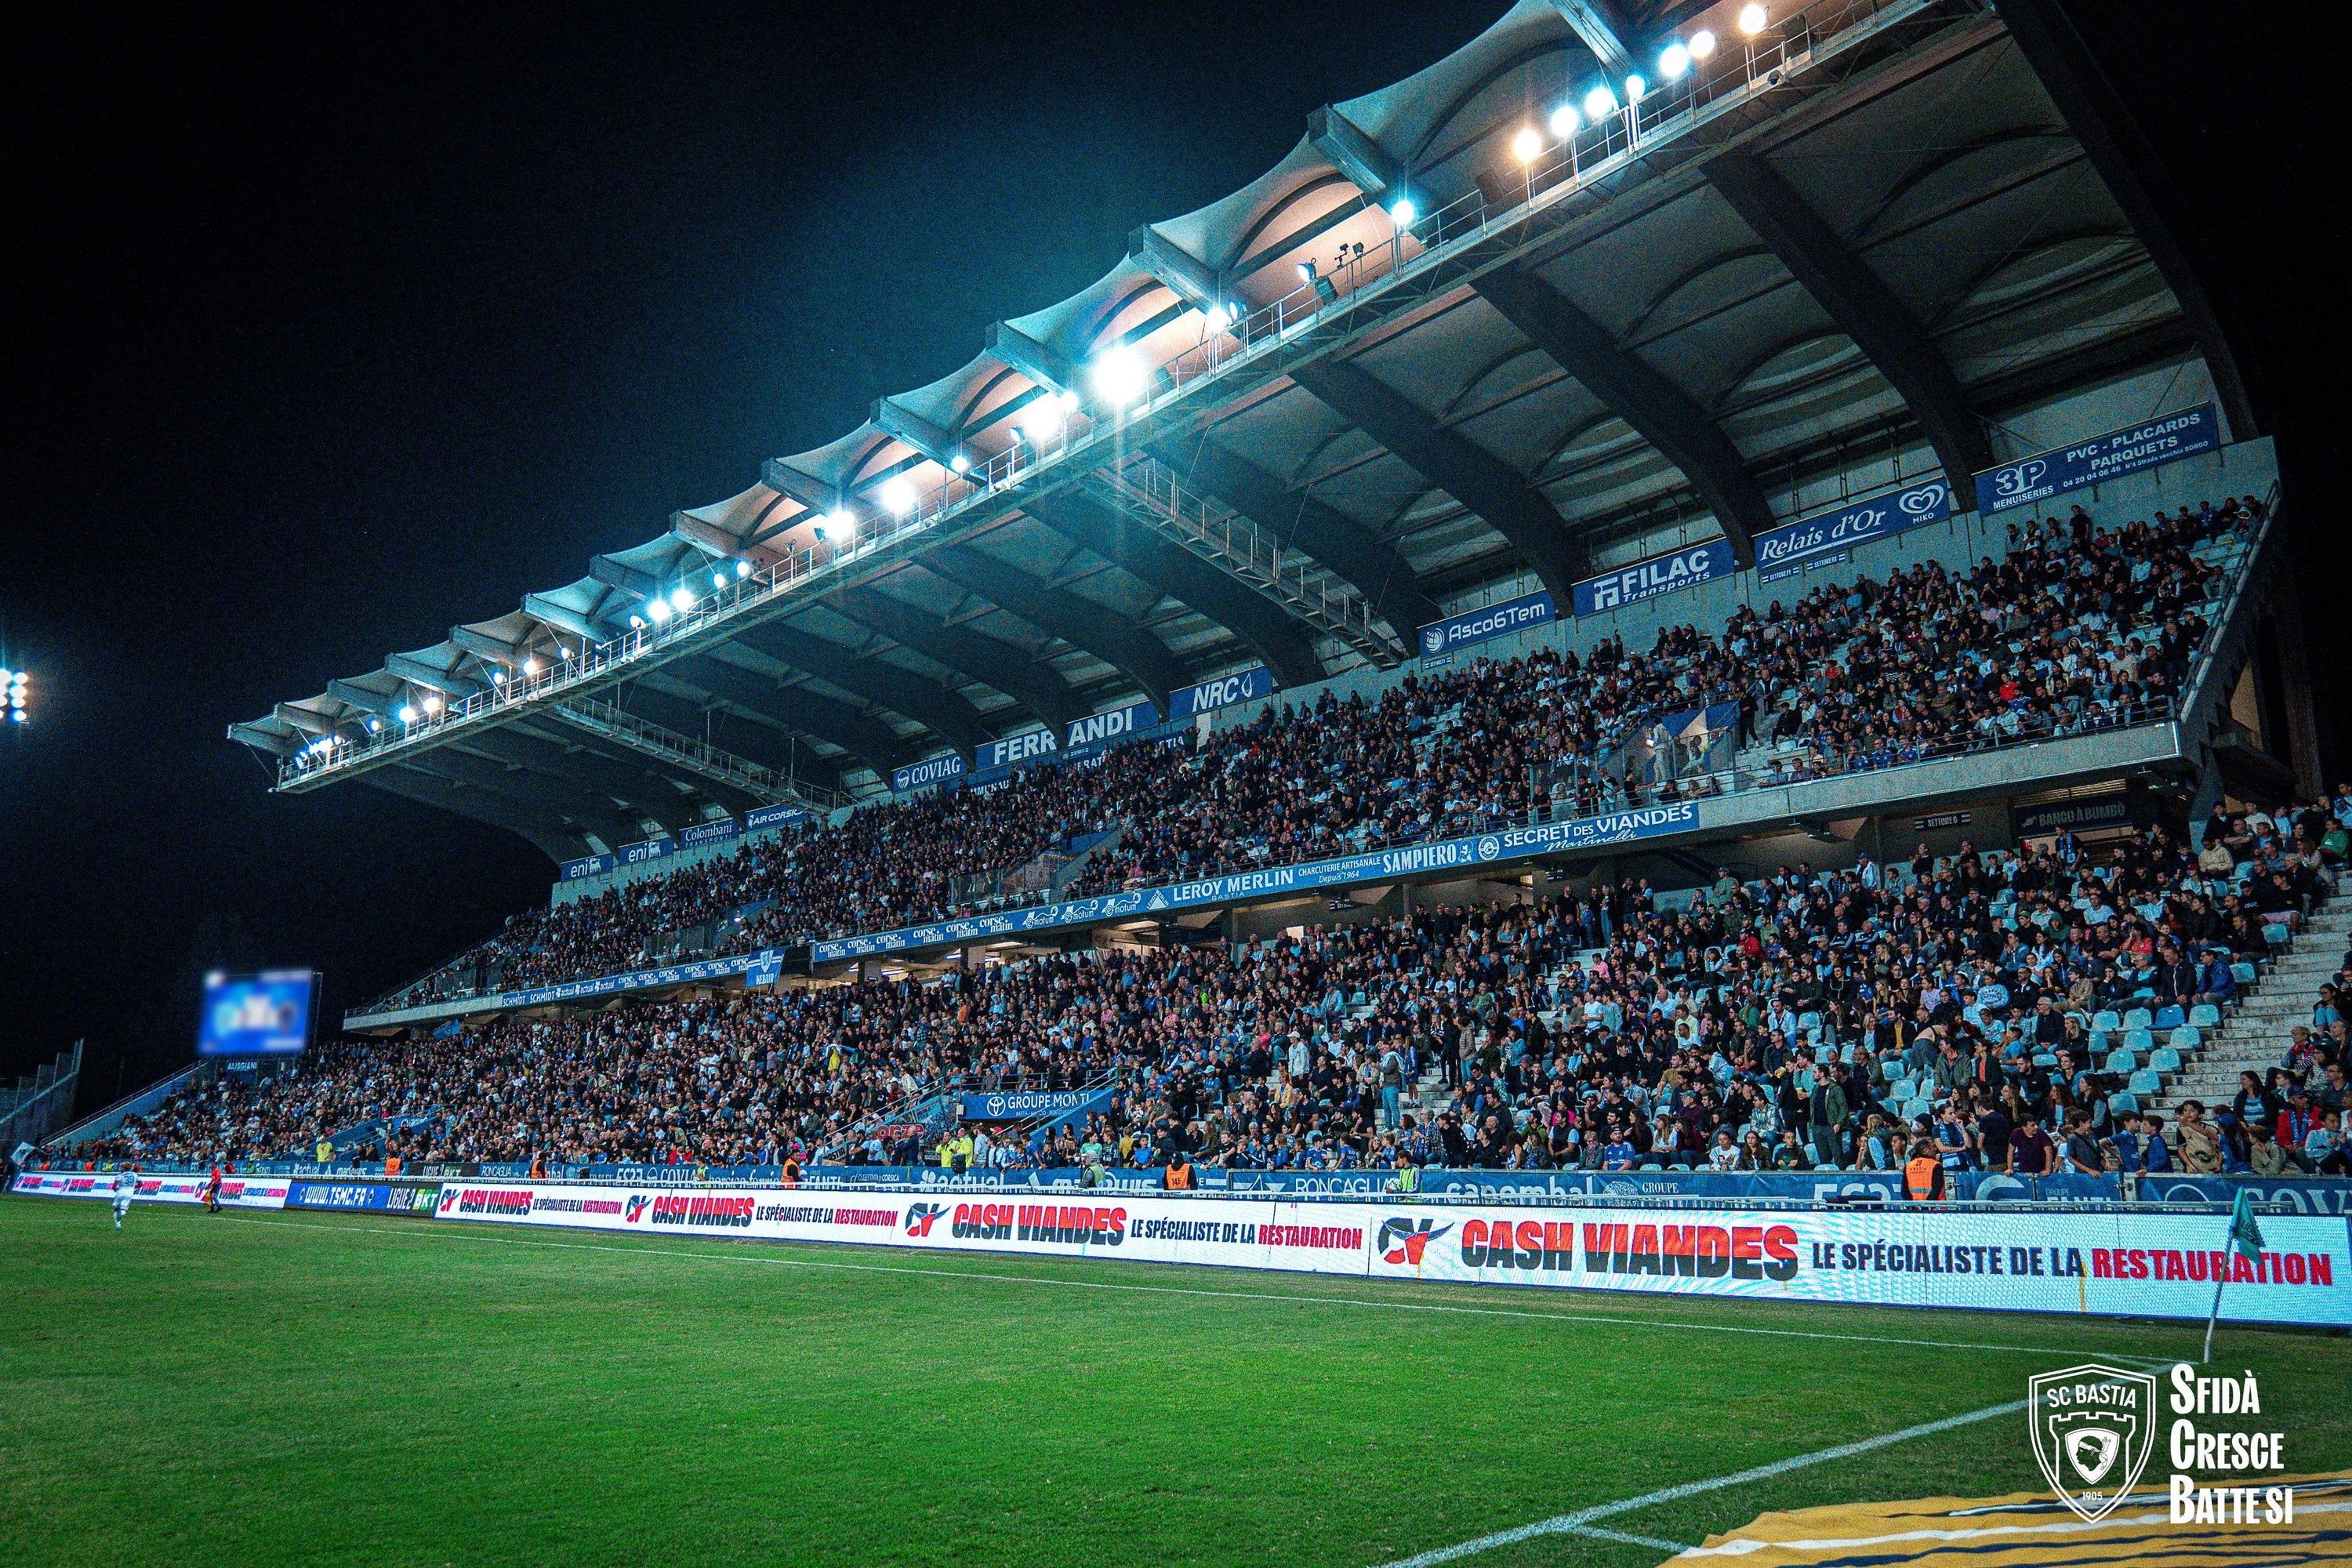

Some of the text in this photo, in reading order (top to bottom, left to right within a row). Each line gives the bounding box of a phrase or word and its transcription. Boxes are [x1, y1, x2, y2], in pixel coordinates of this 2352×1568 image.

[2067, 444, 2099, 463] PVC
[2112, 412, 2201, 448] PLACARDS
[2091, 435, 2178, 470] PARQUETS
[1995, 459, 2045, 495] 3P
[1993, 485, 2054, 510] MENUISERIES
[1912, 512, 1934, 524] MIKO
[1759, 526, 1824, 561] Relais
[1622, 550, 1710, 594] FILAC
[1623, 571, 1710, 603] Transports
[1449, 603, 1544, 642] Asco6Tem
[1192, 677, 1239, 713] NRC
[912, 757, 960, 784] COVIAG
[753, 815, 768, 825] AIR
[1504, 804, 1693, 848] SECRET DES VIANDES
[1928, 816, 1952, 827] SETTORE
[685, 822, 732, 842] Colombani
[1544, 829, 1637, 851] Martinelli
[629, 844, 648, 862] eni
[1383, 844, 1457, 873] SAMPIERO
[571, 859, 588, 878] eni
[1298, 857, 1381, 877] CHARCUTERIE ARTISANALE
[1319, 870, 1359, 884] Depuis 1964
[1174, 869, 1294, 902] LEROY MERLIN
[1212, 891, 1245, 902] BASTIA
[956, 927, 978, 938] matin
[990, 921, 1013, 932] matin
[856, 943, 875, 953] matin
[885, 939, 906, 949] matin
[923, 933, 944, 943] matin
[827, 948, 845, 957] matin
[561, 987, 575, 996] actual
[580, 983, 594, 993] actual
[601, 979, 615, 990] actual
[1007, 1096, 1052, 1109] GROUPE
[124, 1176, 135, 1185] 39
[481, 1166, 511, 1177] RONCAGLIA
[304, 1186, 368, 1206] WWW.TSMC.FR
[1642, 1181, 1679, 1193] GROUPE
[2045, 1188, 2071, 1196] GROUPE
[387, 1188, 411, 1210] LIGUE
[414, 1189, 439, 1210] BKT
[459, 1189, 622, 1215] CASH VIANDES LE SPÉCIALISTE DE LA RESTAURATION
[652, 1195, 898, 1227] CASH VIANDES LE SPÉCIALISTE DE LA RESTAURATION
[952, 1203, 1363, 1250] CASH VIANDES LE SPÉCIALISTE DE LA RESTAURATION
[1461, 1219, 2333, 1286] CASH VIANDES LE SPÉCIALISTE DE LA RESTAURATION
